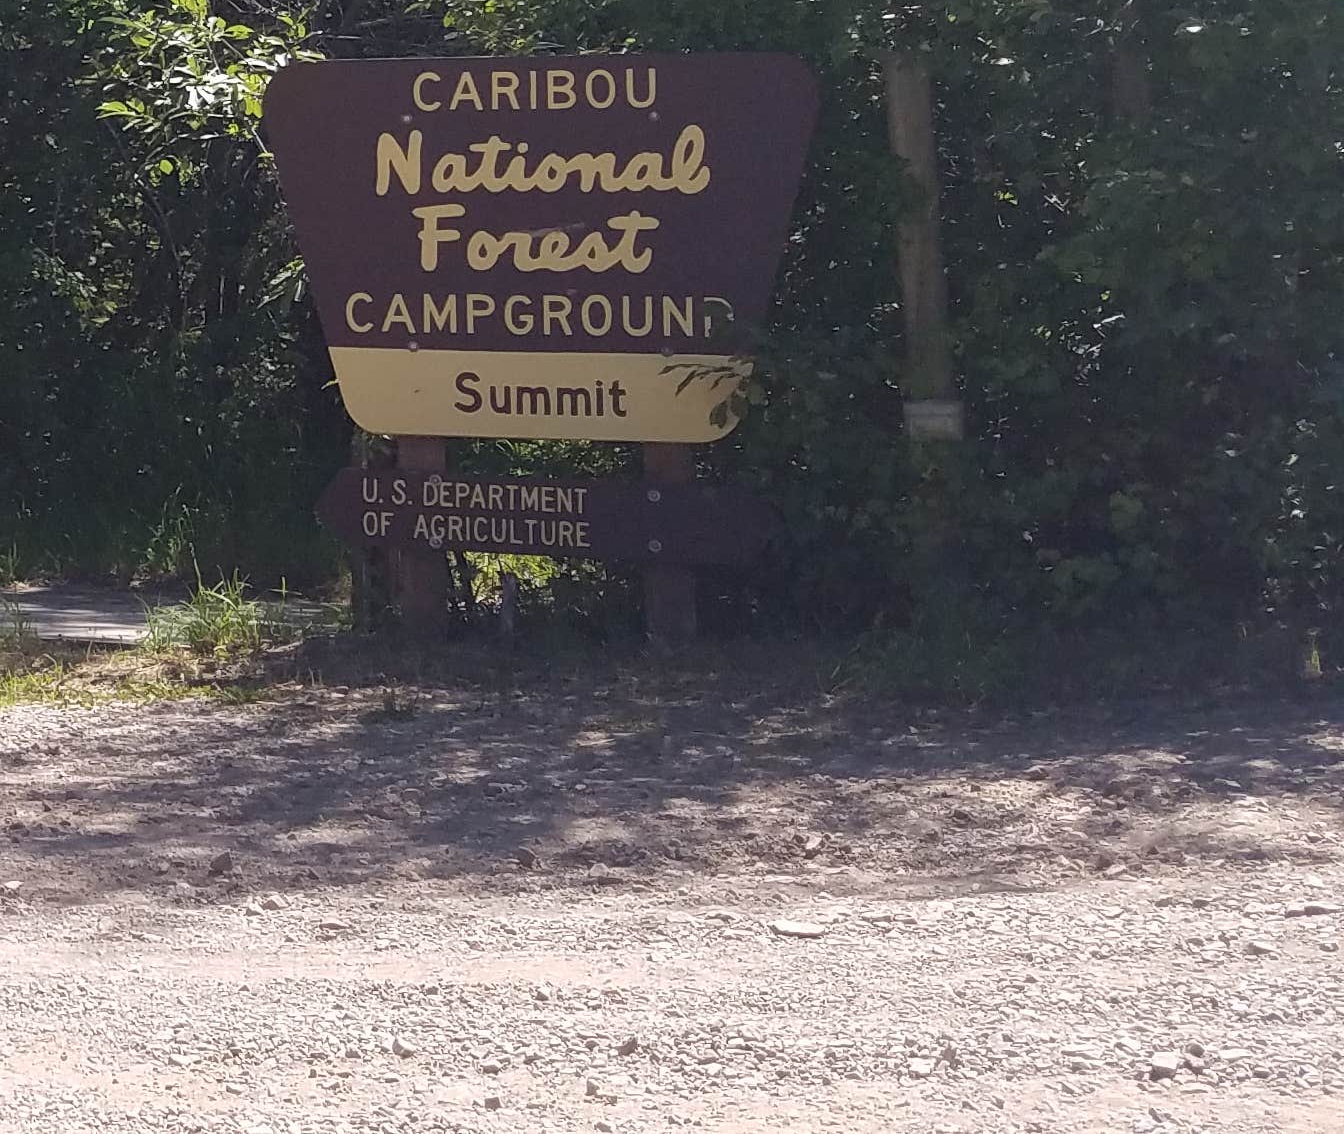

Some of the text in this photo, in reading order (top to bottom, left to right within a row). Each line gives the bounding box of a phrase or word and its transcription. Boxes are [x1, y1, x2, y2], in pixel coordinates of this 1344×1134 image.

[413, 68, 657, 112] CARIBOU
[376, 124, 711, 196] National
[412, 204, 660, 274] Forest
[454, 371, 628, 418] Summit
[423, 480, 588, 515] DEPARTMENT
[362, 512, 591, 548] OF AGRICULTURE
